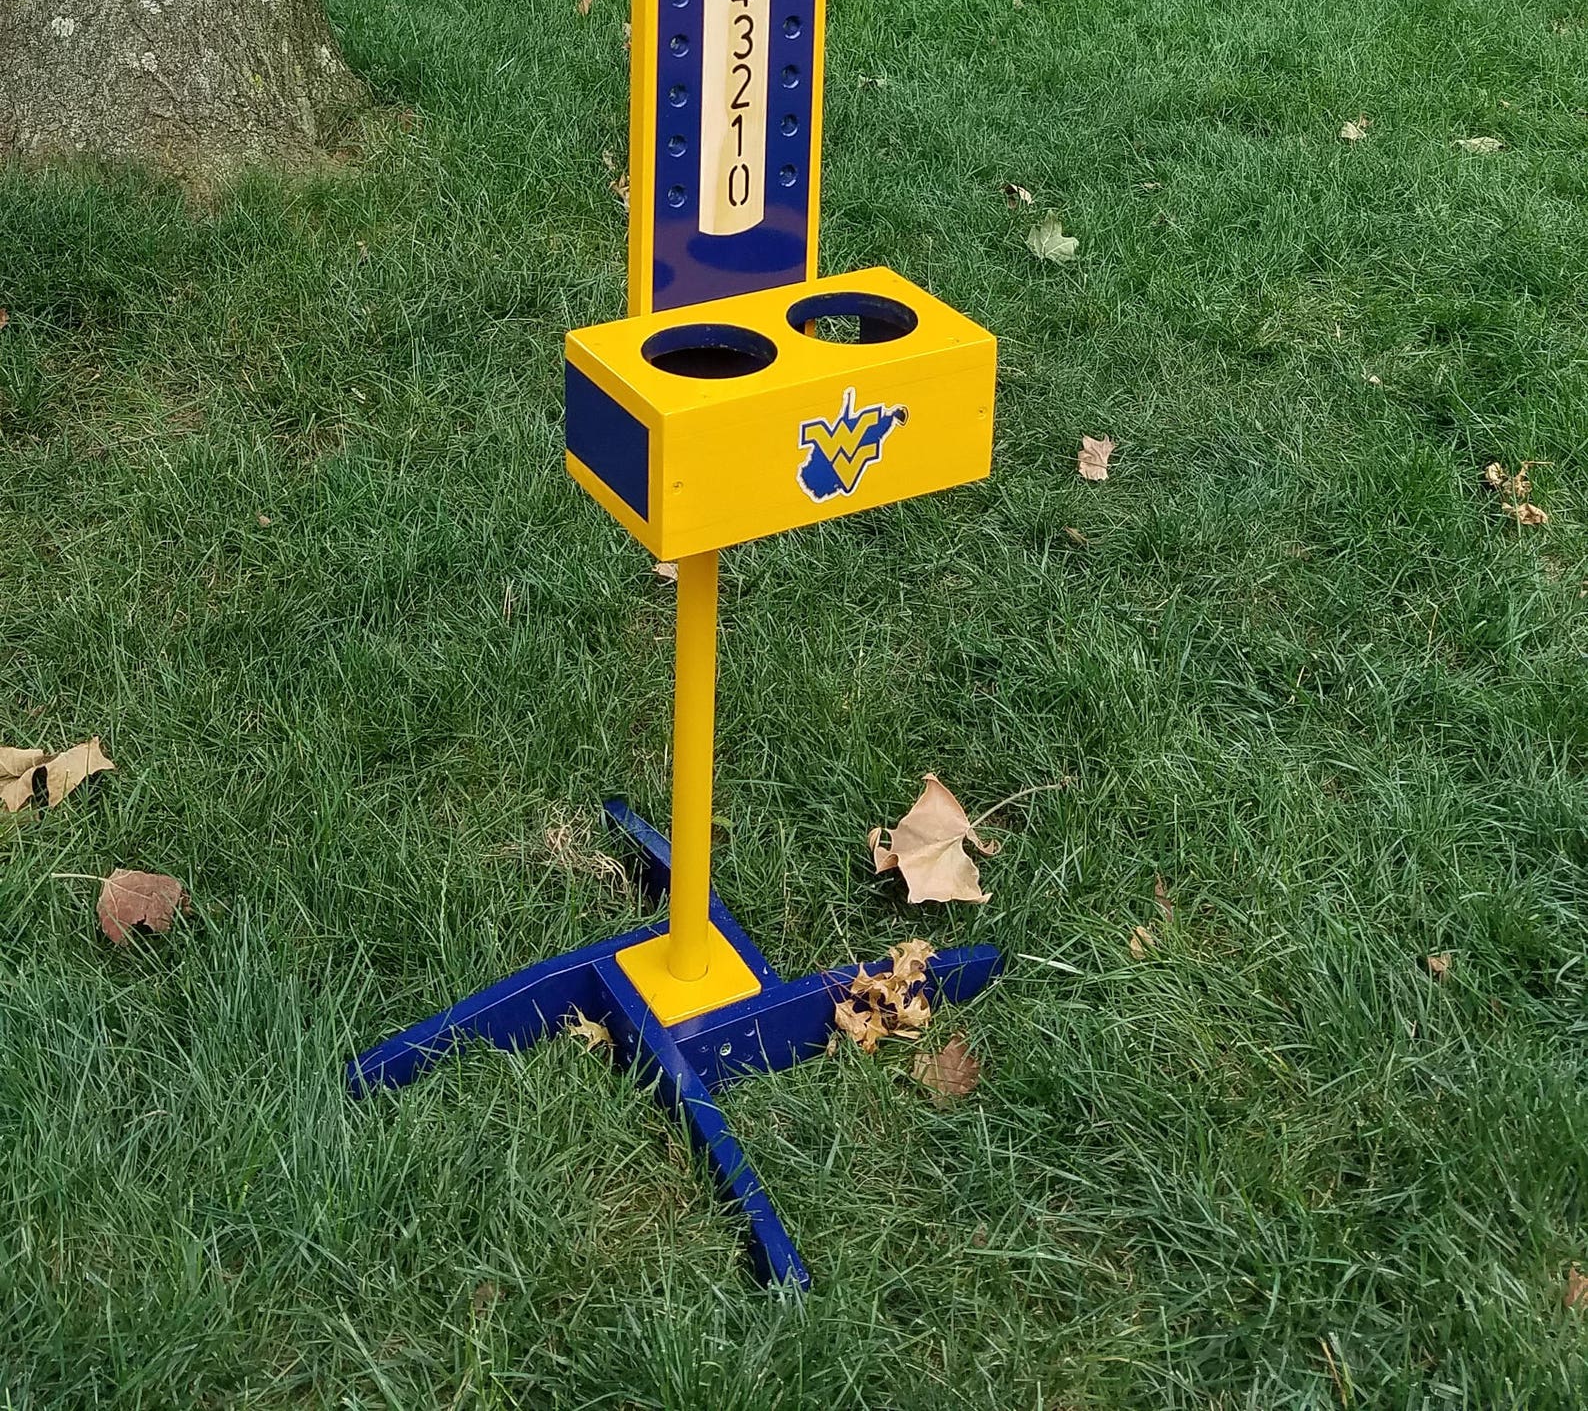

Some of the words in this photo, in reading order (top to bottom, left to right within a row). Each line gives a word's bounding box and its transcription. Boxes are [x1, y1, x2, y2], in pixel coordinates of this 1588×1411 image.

[732, 13, 755, 60] 3
[729, 62, 753, 110] 2
[730, 112, 744, 157] 1
[727, 162, 751, 207] 0
